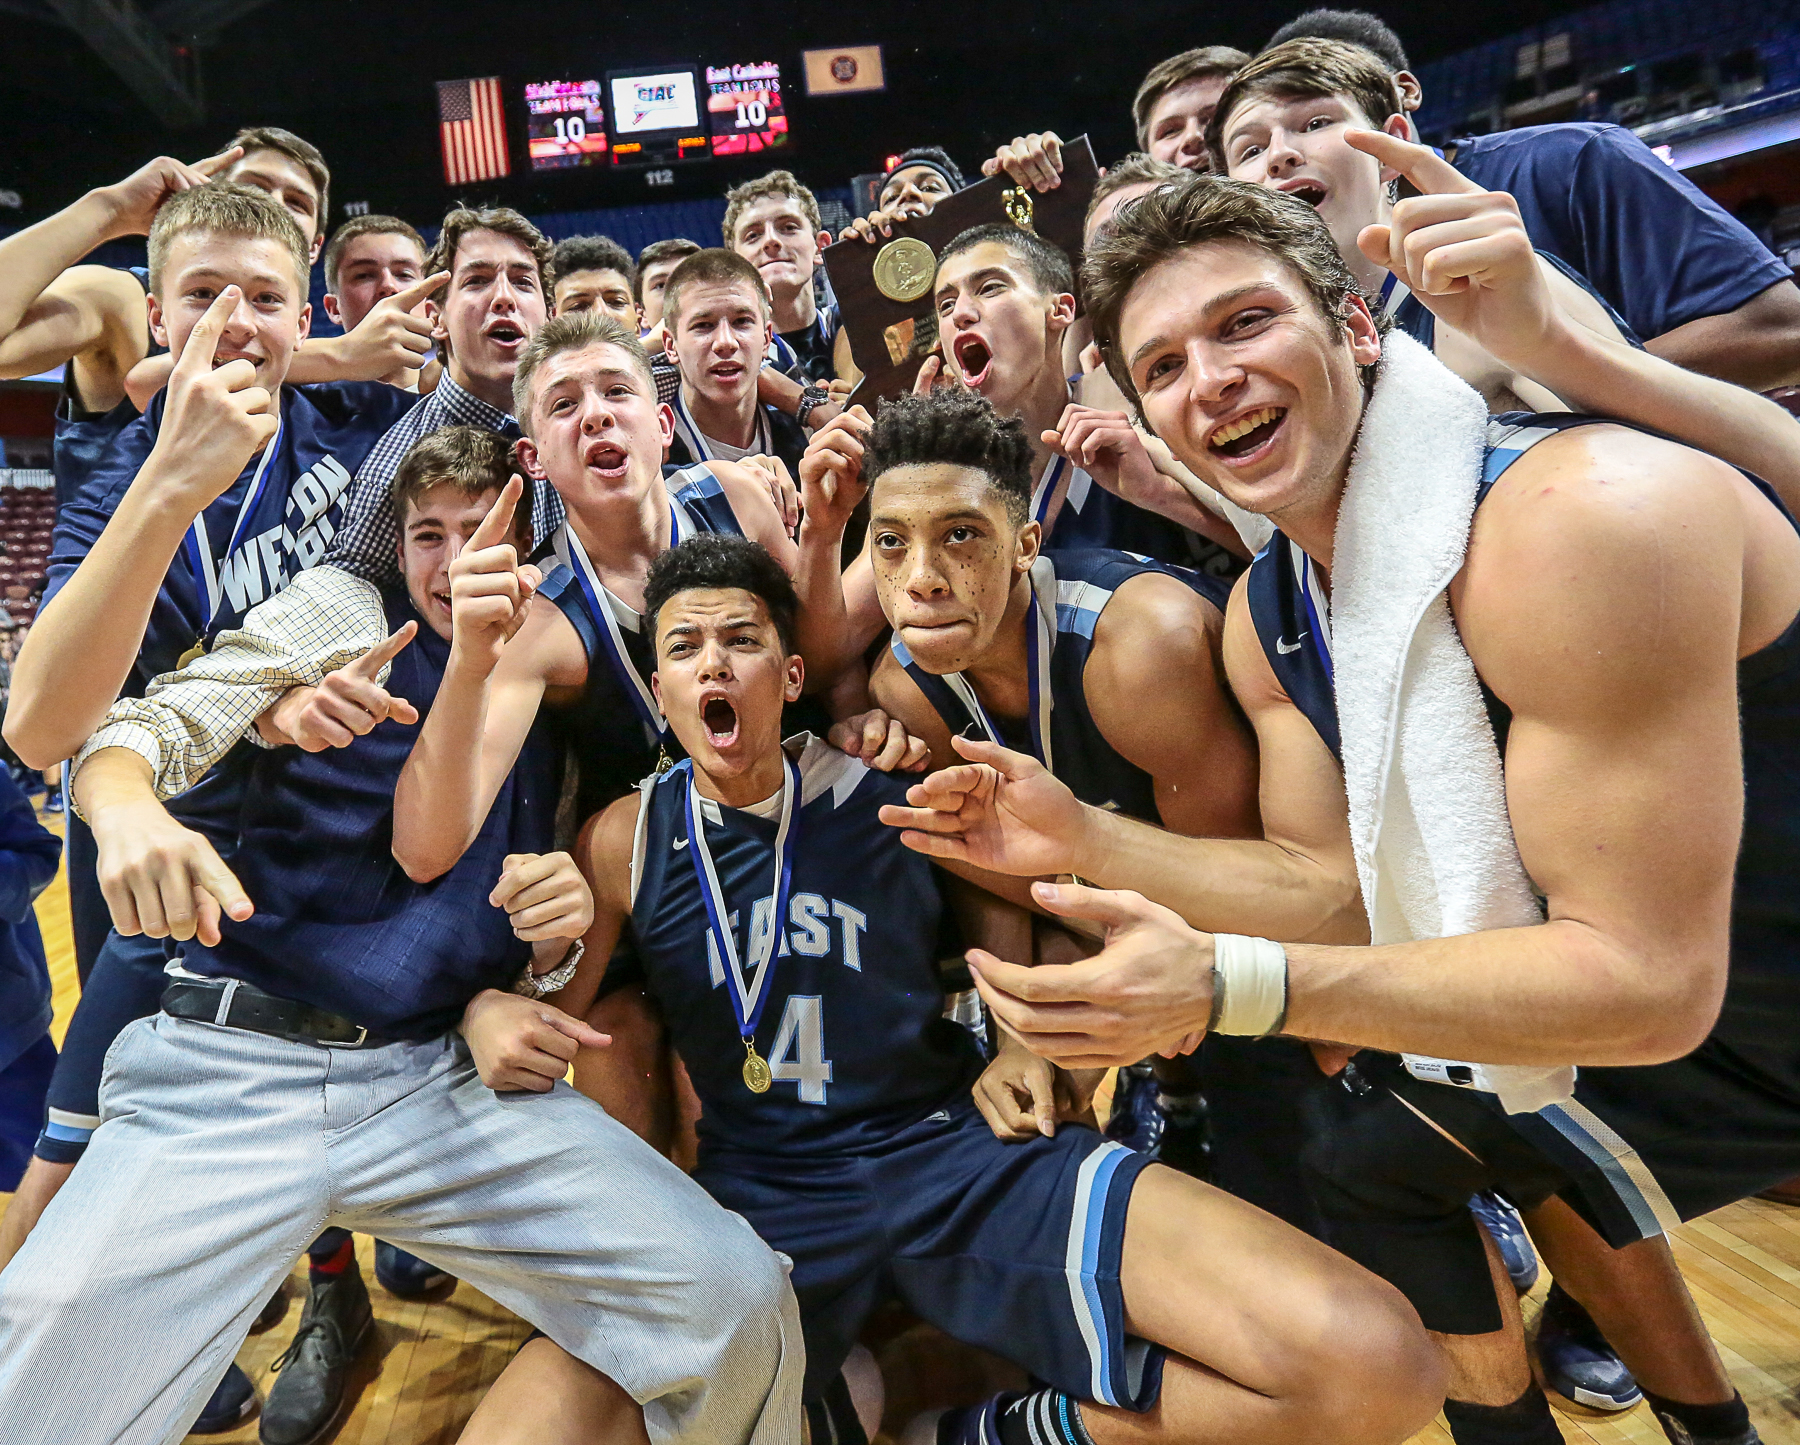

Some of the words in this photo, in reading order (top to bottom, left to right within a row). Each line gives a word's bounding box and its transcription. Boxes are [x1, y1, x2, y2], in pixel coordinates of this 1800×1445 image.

[735, 100, 767, 129] 10
[553, 117, 586, 144] 10
[645, 168, 674, 187] 112
[343, 200, 370, 216] 111
[218, 453, 352, 614] WEON
[705, 892, 867, 989] EAST
[767, 994, 834, 1105] 4
